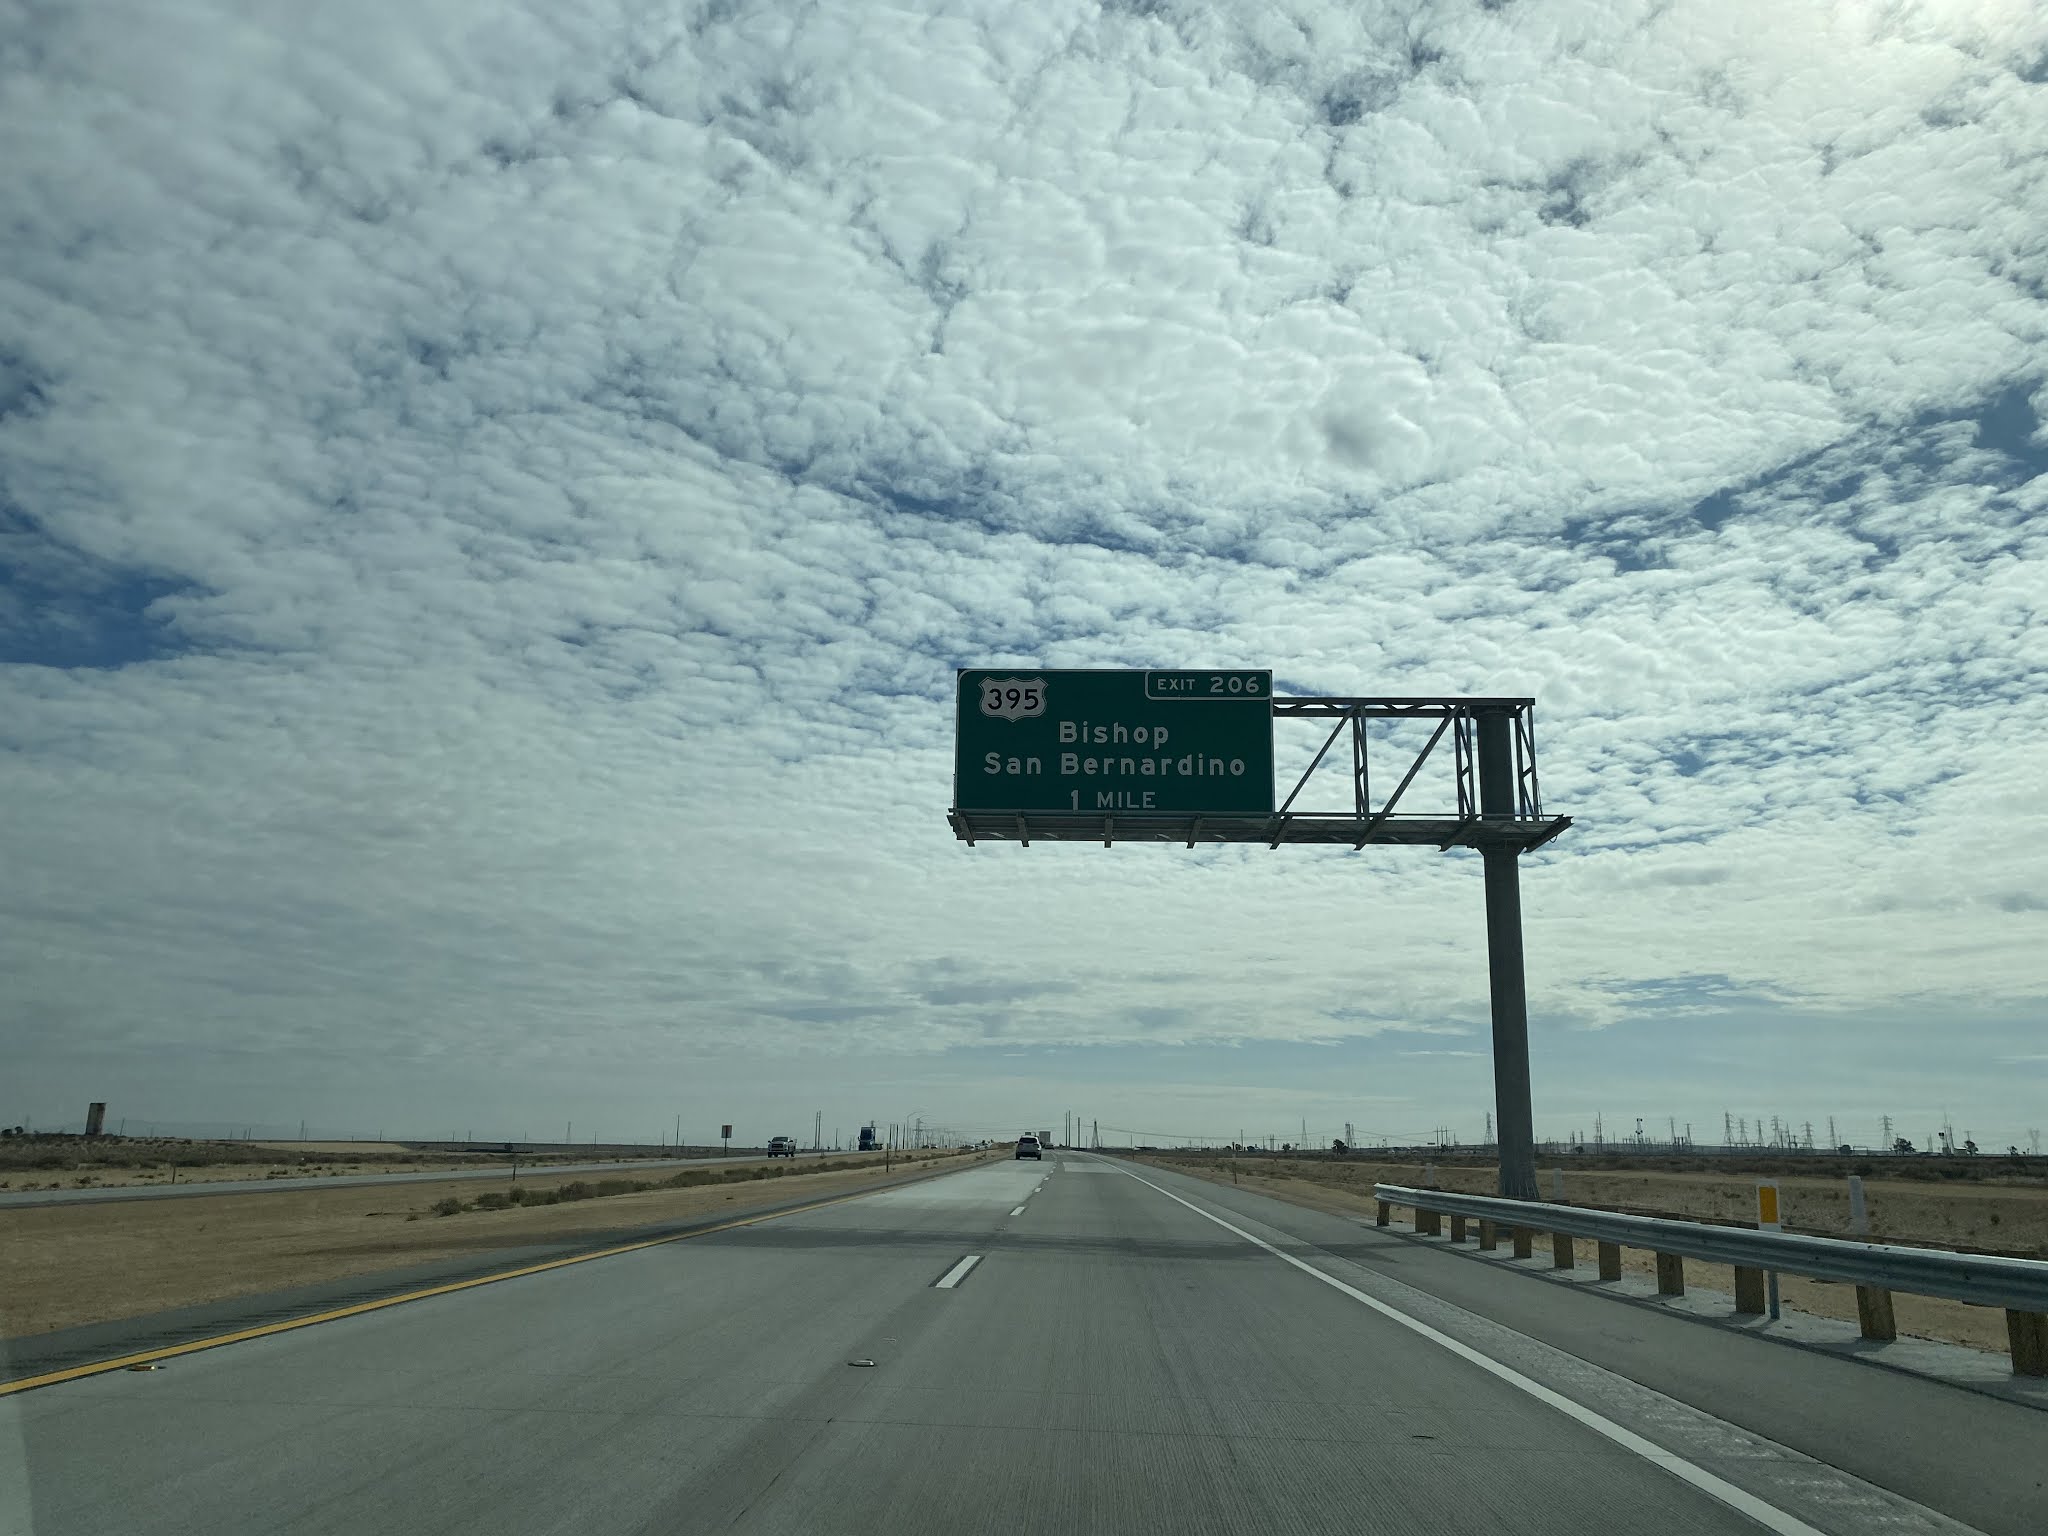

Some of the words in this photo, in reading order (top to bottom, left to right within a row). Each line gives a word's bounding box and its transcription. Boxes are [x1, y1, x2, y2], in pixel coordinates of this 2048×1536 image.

[1157, 678, 1196, 691] EXIT
[1209, 676, 1260, 693] 206
[987, 688, 1040, 710] 395
[1059, 720, 1169, 750] Bishop
[983, 752, 1042, 775] San
[1060, 753, 1246, 776] Bernardino
[1070, 789, 1079, 811] 1
[1096, 791, 1157, 809] MILE
